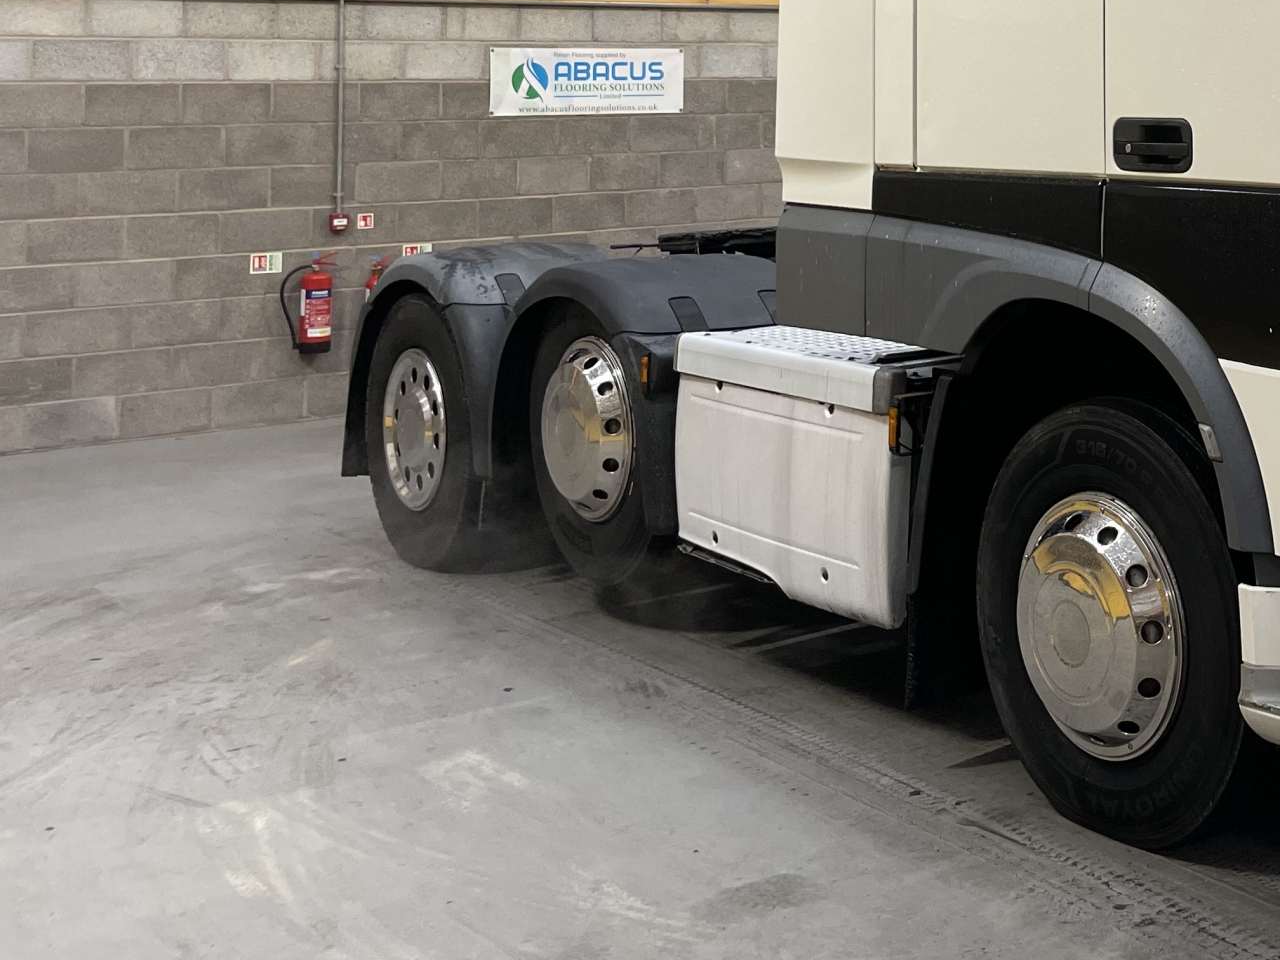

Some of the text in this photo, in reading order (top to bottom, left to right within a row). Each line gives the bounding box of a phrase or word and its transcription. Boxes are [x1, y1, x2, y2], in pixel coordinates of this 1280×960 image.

[571, 51, 595, 59] Flooring
[554, 61, 665, 81] ABACUS
[553, 82, 665, 92] FLOORING SOLUTIONS
[518, 103, 659, 114] www.abacusflooringsolutions.co.uk
